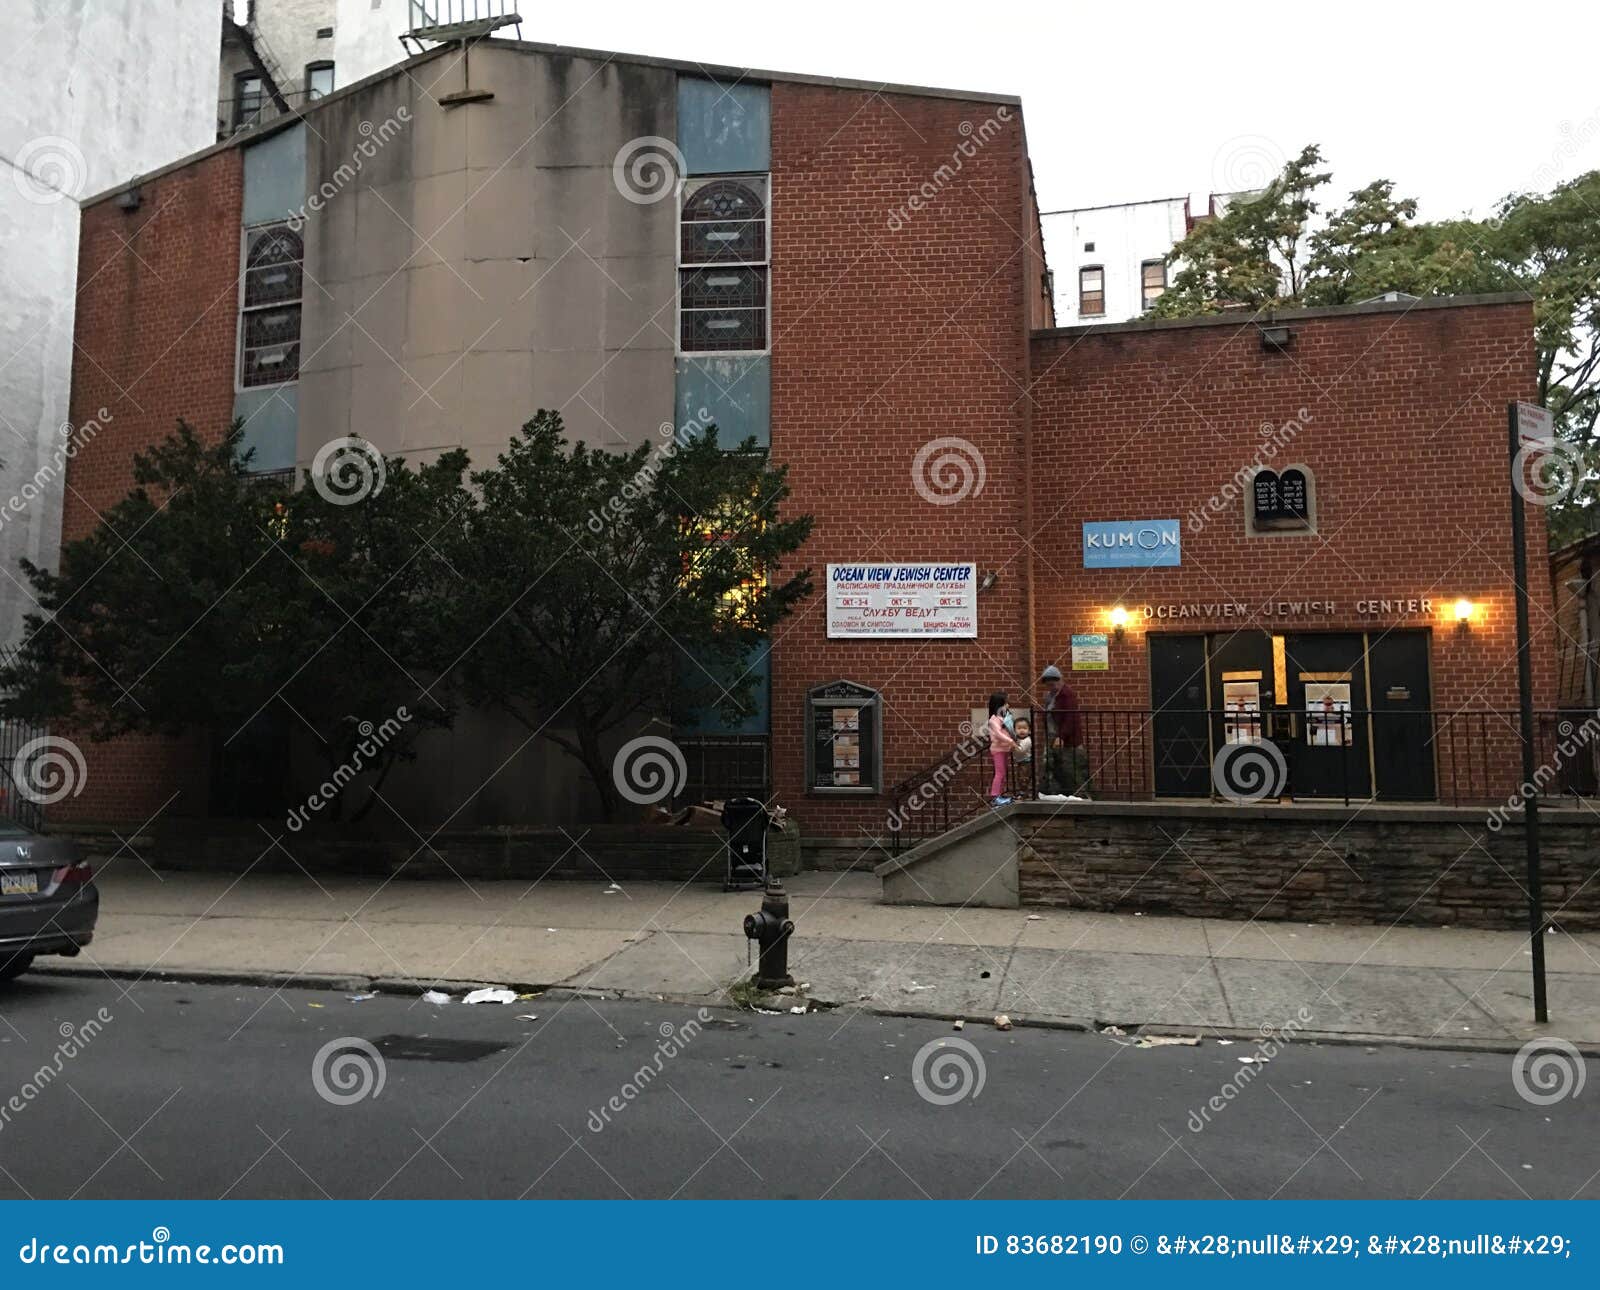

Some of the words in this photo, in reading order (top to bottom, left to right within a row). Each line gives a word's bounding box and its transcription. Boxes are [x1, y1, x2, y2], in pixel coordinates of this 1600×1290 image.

[1087, 529, 1176, 549] KUMON
[833, 567, 865, 581] OCEAN
[867, 567, 892, 581] VIEW
[893, 567, 931, 581] JEWISH
[933, 566, 971, 581] CENTER
[836, 582, 881, 590] РАСПИСАНИЕ
[936, 582, 966, 590] СЛУЖБЫ
[863, 608, 900, 617] СЛУЖБУ
[905, 608, 939, 618] ВЕДУТ
[1143, 603, 1248, 618] OCEANVIEW
[1264, 601, 1336, 615] JEWISH
[1356, 599, 1432, 614] CENTER
